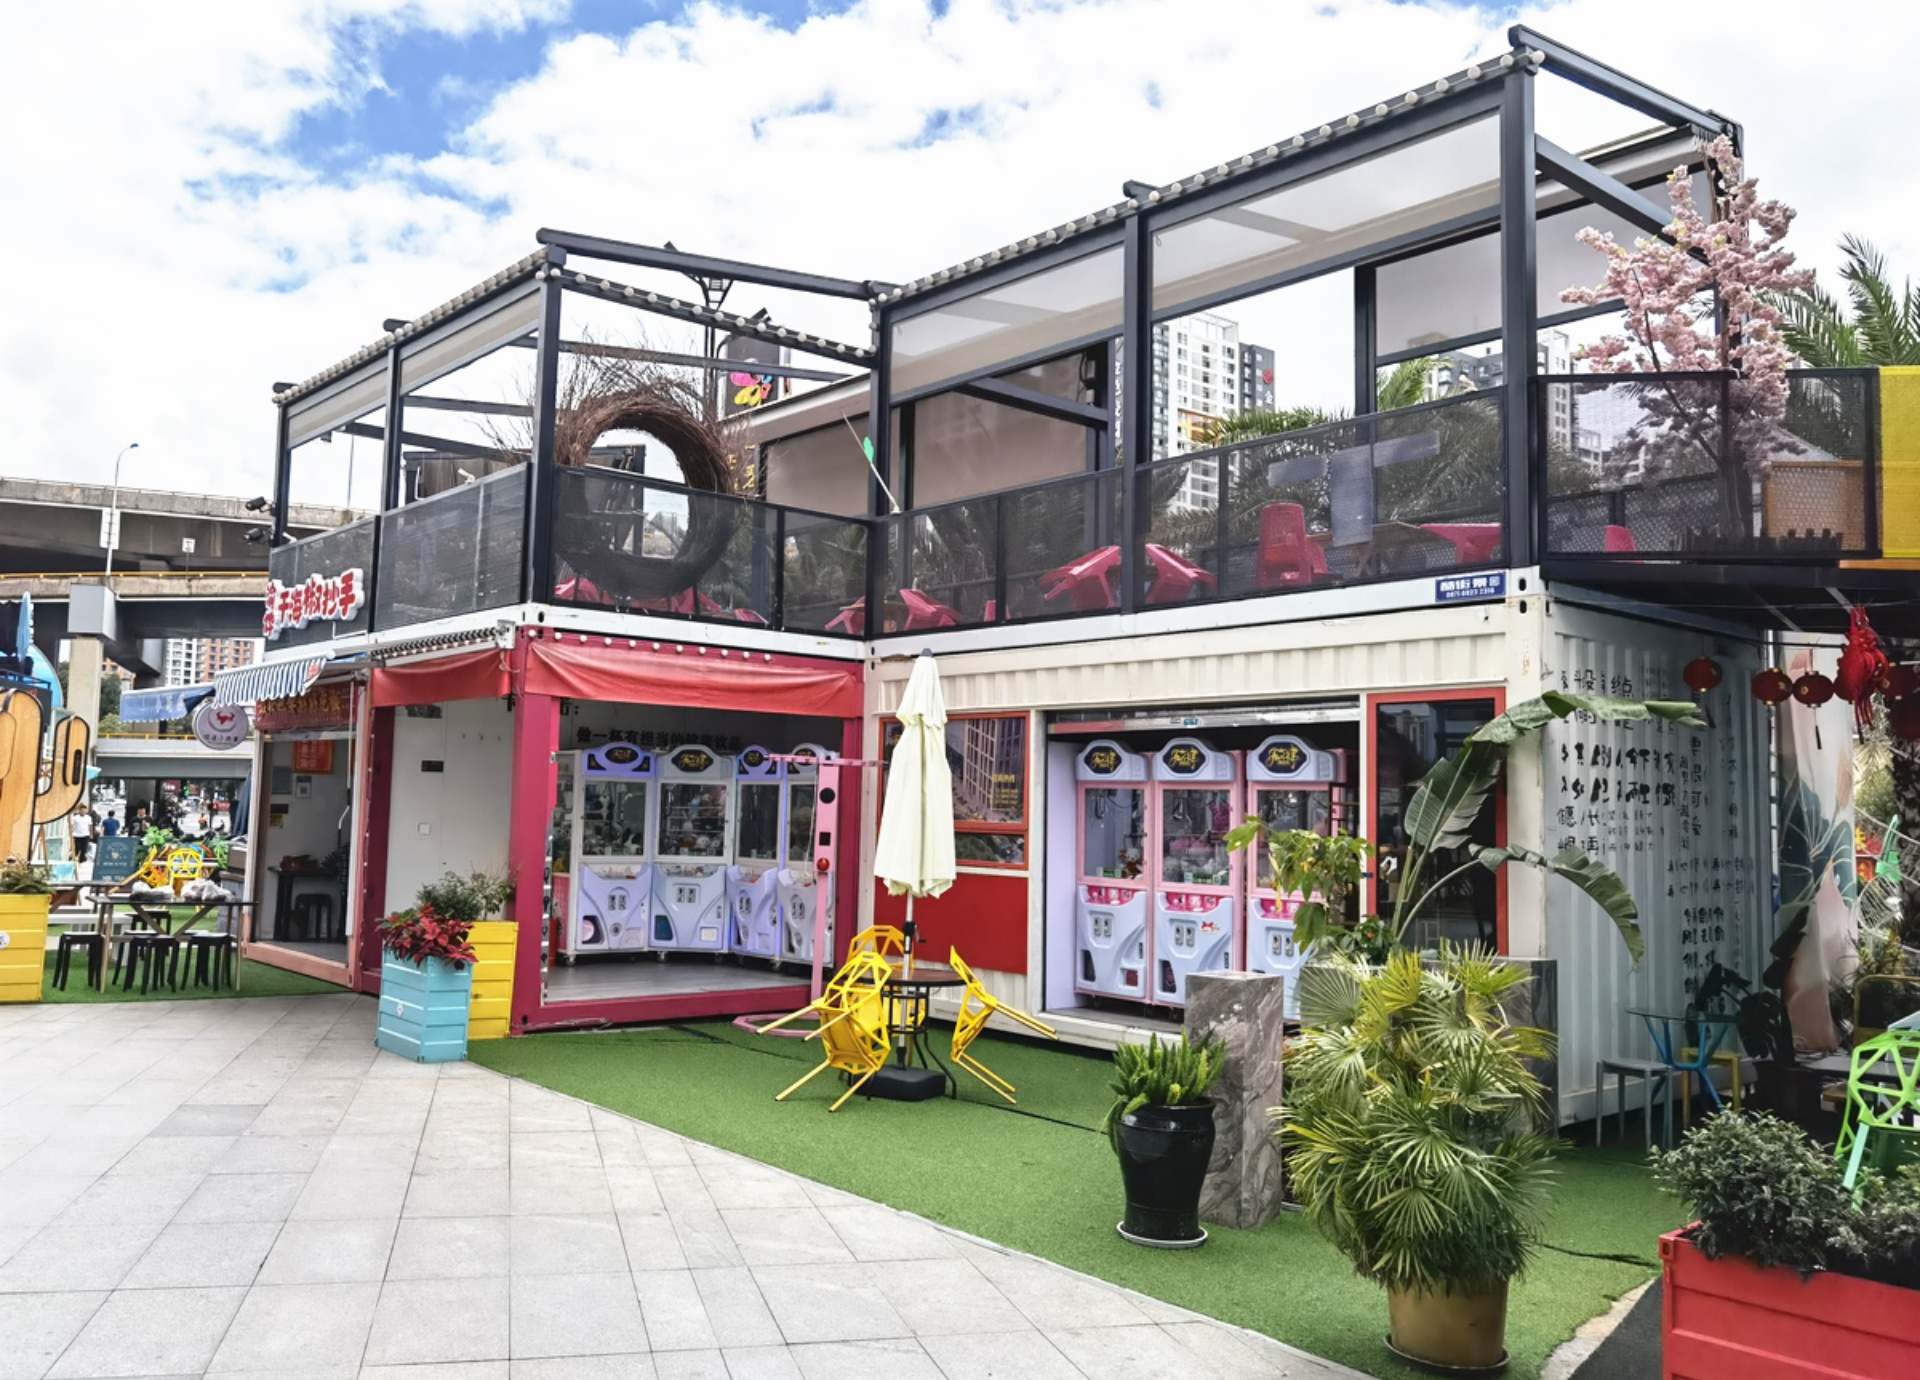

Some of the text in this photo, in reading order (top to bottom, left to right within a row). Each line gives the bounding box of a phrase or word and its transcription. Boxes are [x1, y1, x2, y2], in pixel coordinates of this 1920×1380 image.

[278, 571, 355, 624] 干海椒抄手
